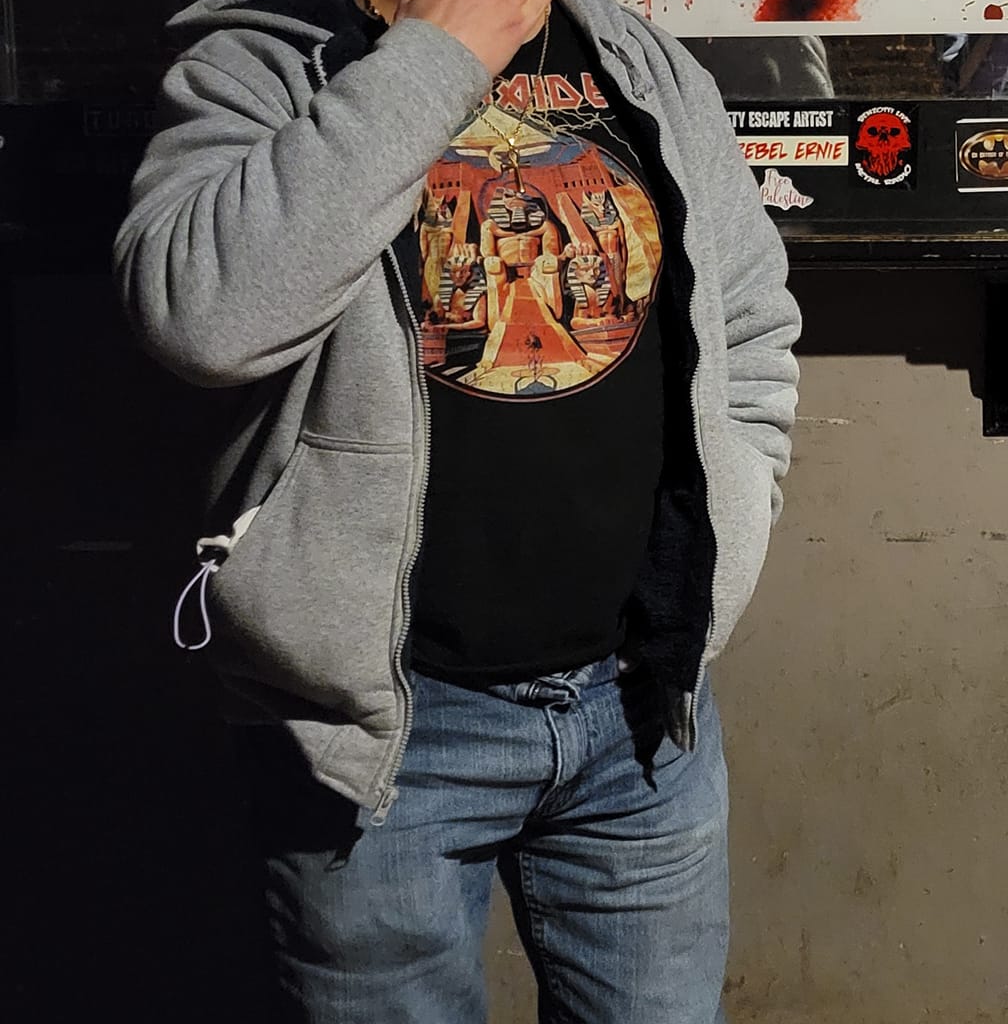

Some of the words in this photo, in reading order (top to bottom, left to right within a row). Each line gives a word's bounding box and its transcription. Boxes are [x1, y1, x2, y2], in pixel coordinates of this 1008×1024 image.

[727, 111, 746, 128] TY
[748, 111, 790, 128] ESCAPE
[795, 141, 846, 161] ERNIE
[855, 163, 881, 185] METAL
[884, 164, 912, 185] RADIO
